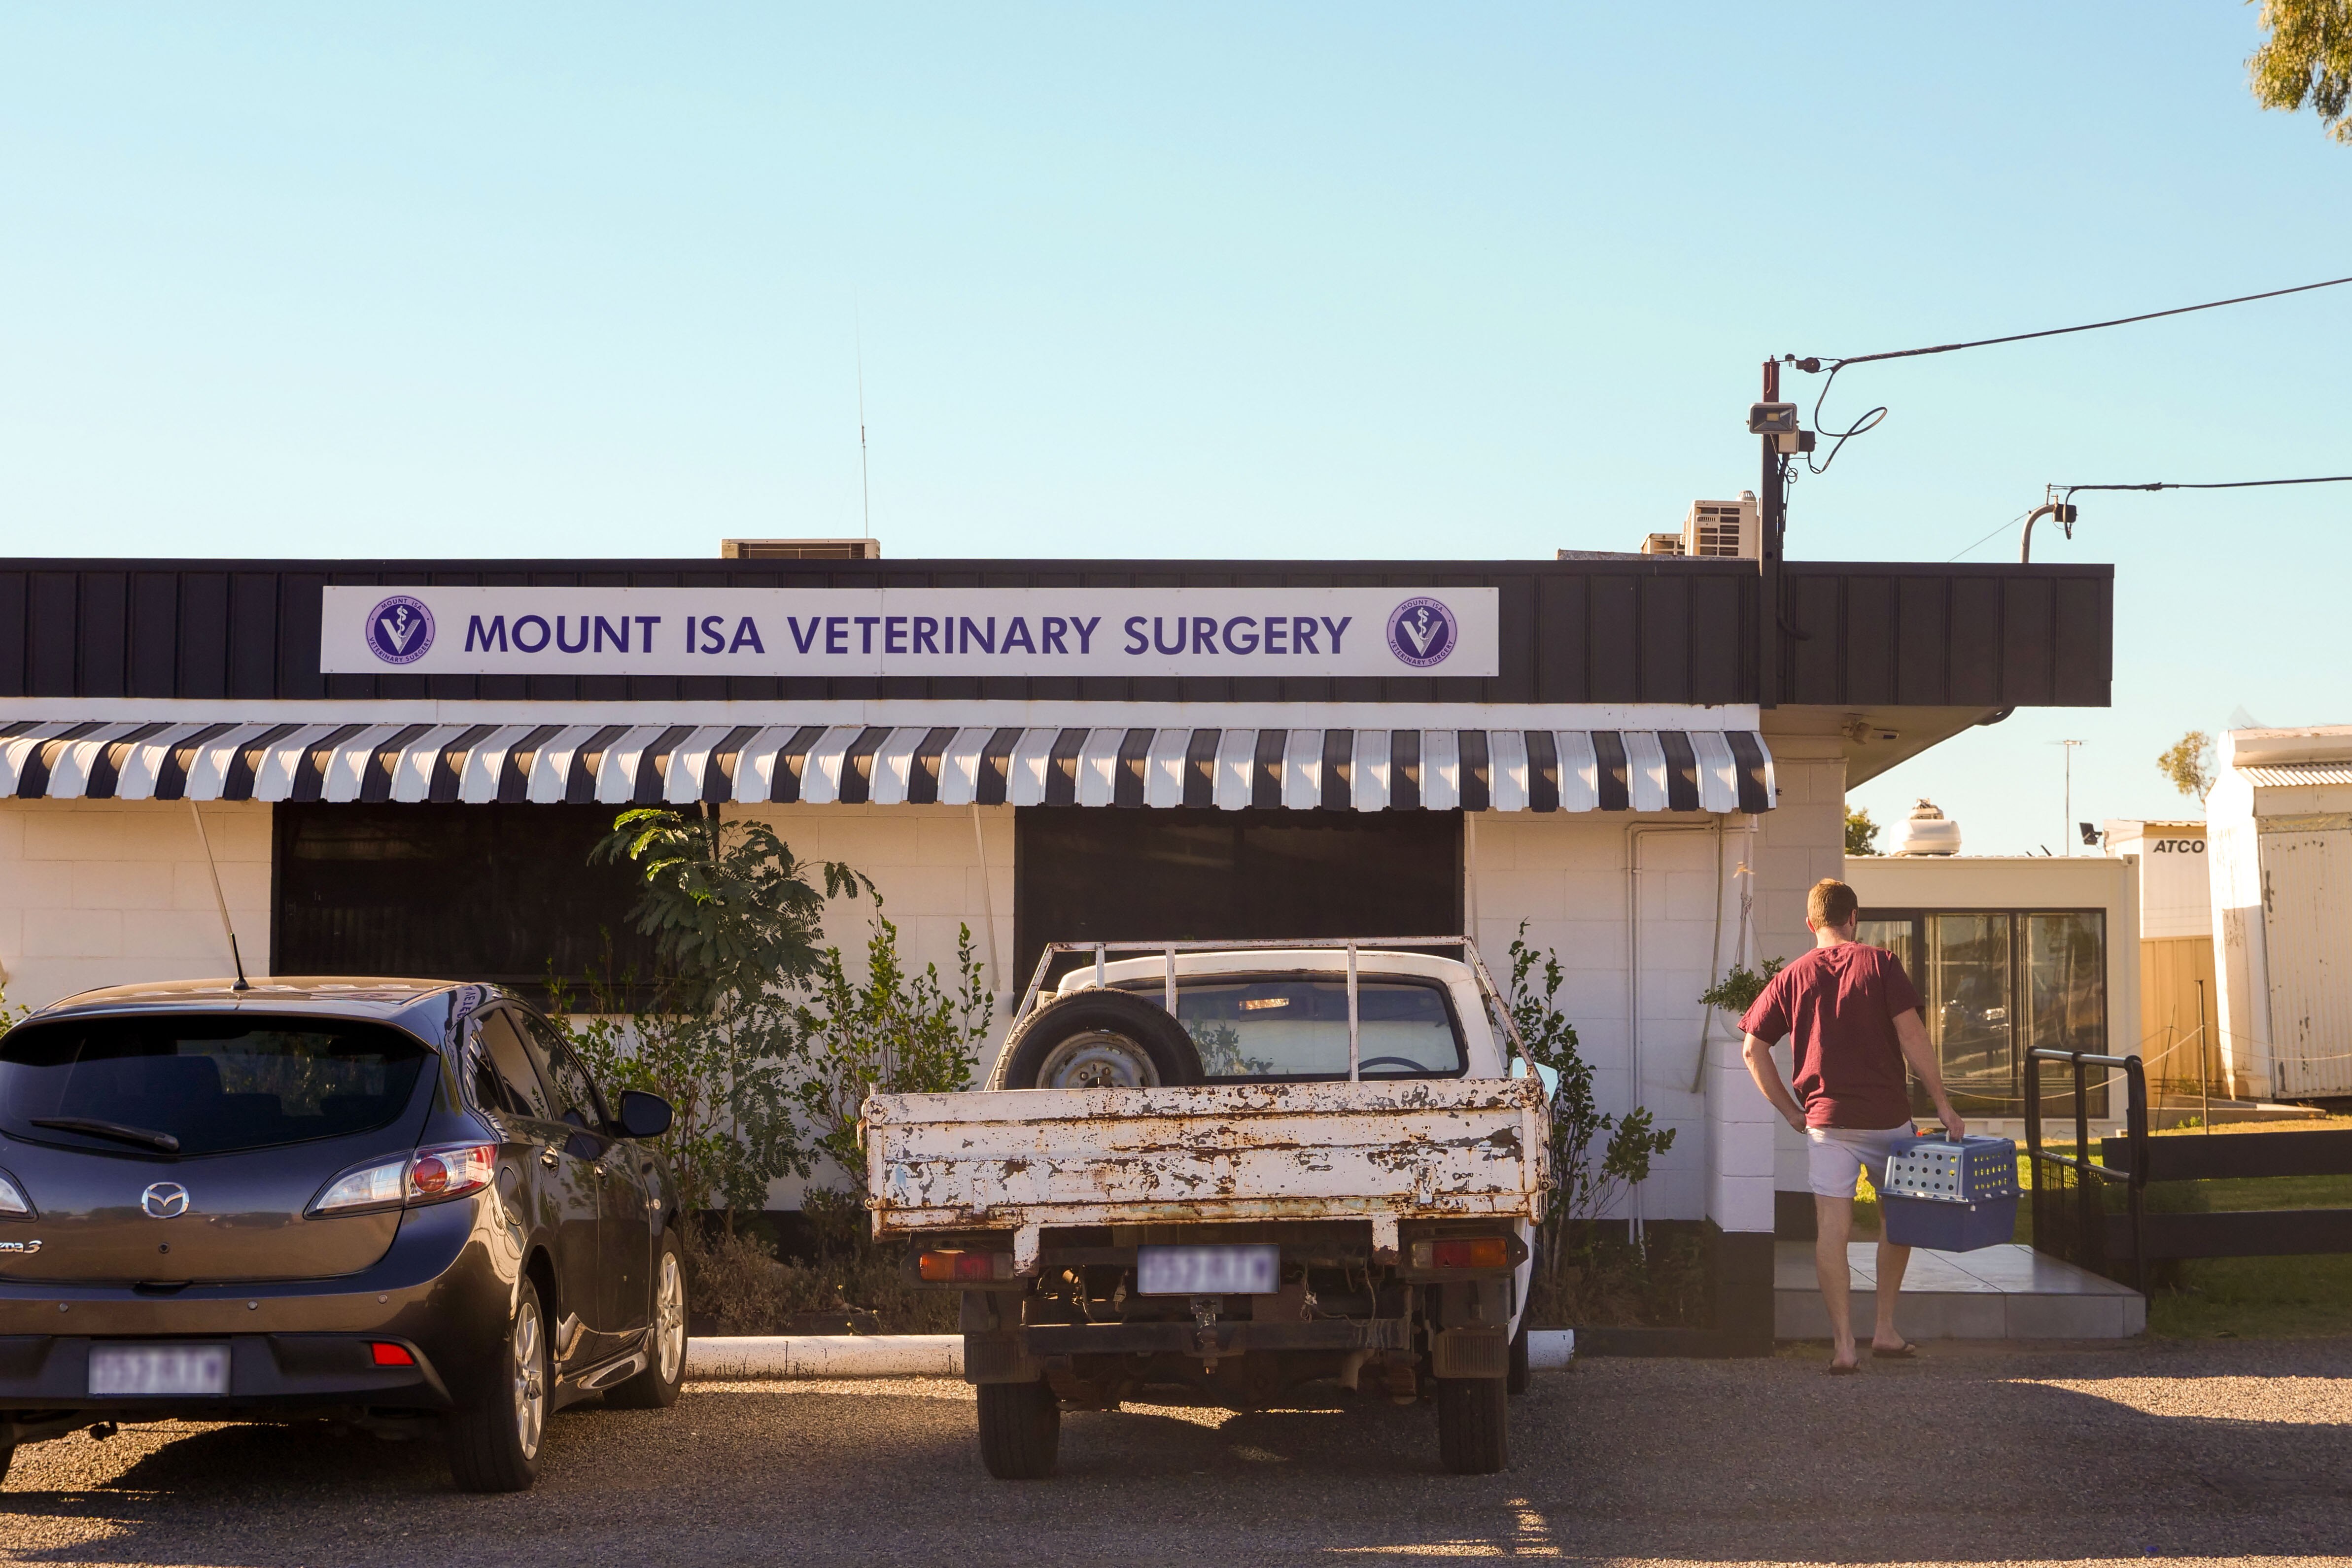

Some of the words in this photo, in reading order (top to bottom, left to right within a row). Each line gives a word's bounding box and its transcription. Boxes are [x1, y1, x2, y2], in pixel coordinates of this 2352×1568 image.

[381, 598, 408, 610] MOUNT
[411, 601, 422, 611] ISA
[1401, 599, 1428, 612] MOUNT
[1432, 602, 1443, 612] ISA
[464, 615, 661, 653] MOUNT
[686, 615, 765, 654] ISA
[787, 616, 1101, 654] VETERINARY
[1124, 616, 1352, 655] SURGERY
[369, 637, 403, 662] VETERINARY
[406, 638, 431, 662] SURGERY
[1390, 639, 1426, 665] VETERINARY
[1428, 640, 1453, 664] SURGERY
[2153, 840, 2205, 853] ATCO
